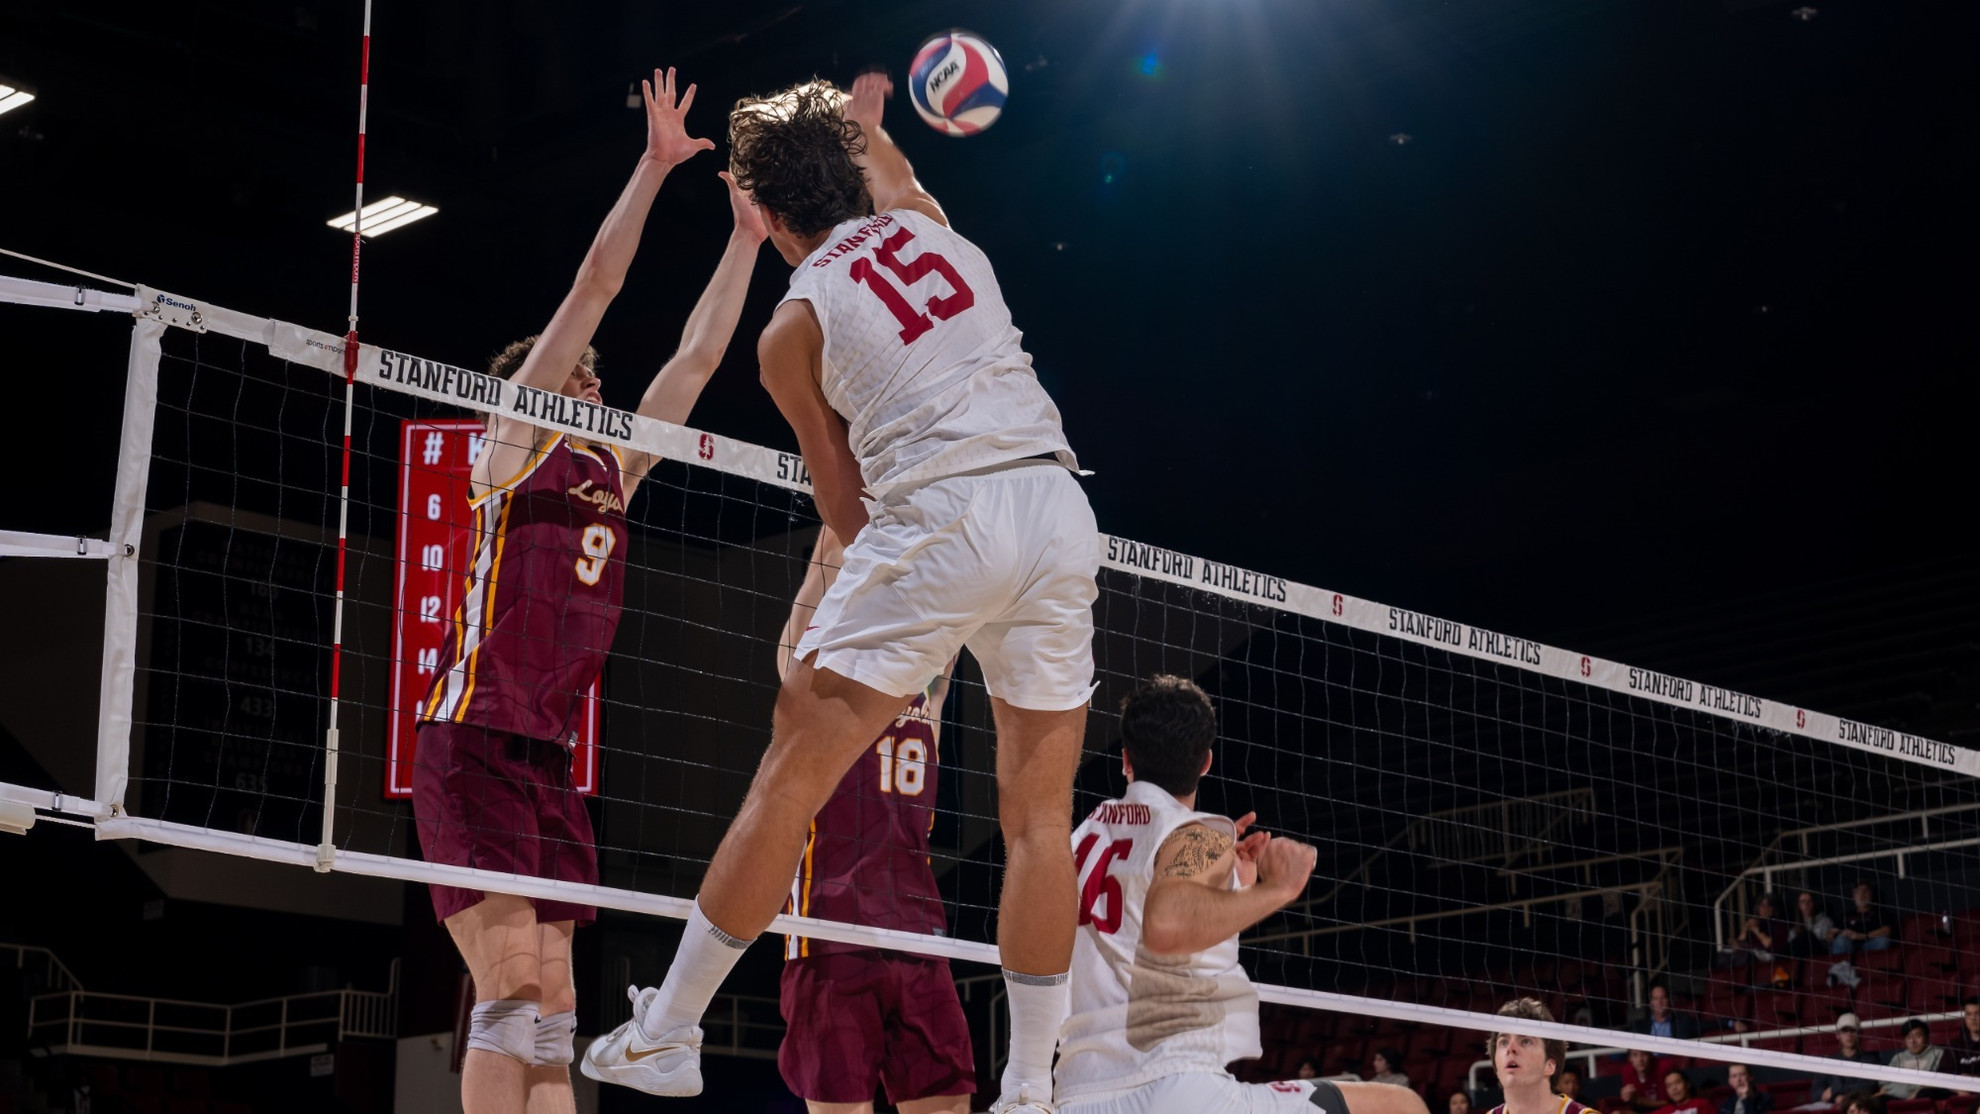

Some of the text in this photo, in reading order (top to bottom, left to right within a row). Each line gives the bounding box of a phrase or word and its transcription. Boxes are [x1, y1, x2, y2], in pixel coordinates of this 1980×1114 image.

[929, 61, 960, 93] NCAA
[165, 297, 197, 312] Senoh
[849, 226, 975, 346] 15
[379, 350, 633, 441] STANFORD ATHLETICS
[427, 493, 441, 520] 6
[422, 544, 443, 572] 10
[575, 523, 617, 587] 9
[1108, 536, 1287, 603] STANFORD ATHLETICS
[420, 595, 441, 623] 12
[418, 647, 438, 675] 14
[1389, 608, 1541, 666] STANFORD ATHLETICS
[1629, 668, 1762, 719] STANFORD ATHLETICS
[876, 736, 928, 796] 18
[1838, 718, 1955, 765] STANFORD ATHLETICS
[1087, 803, 1151, 825] ANFORD
[1074, 832, 1133, 935] 16
